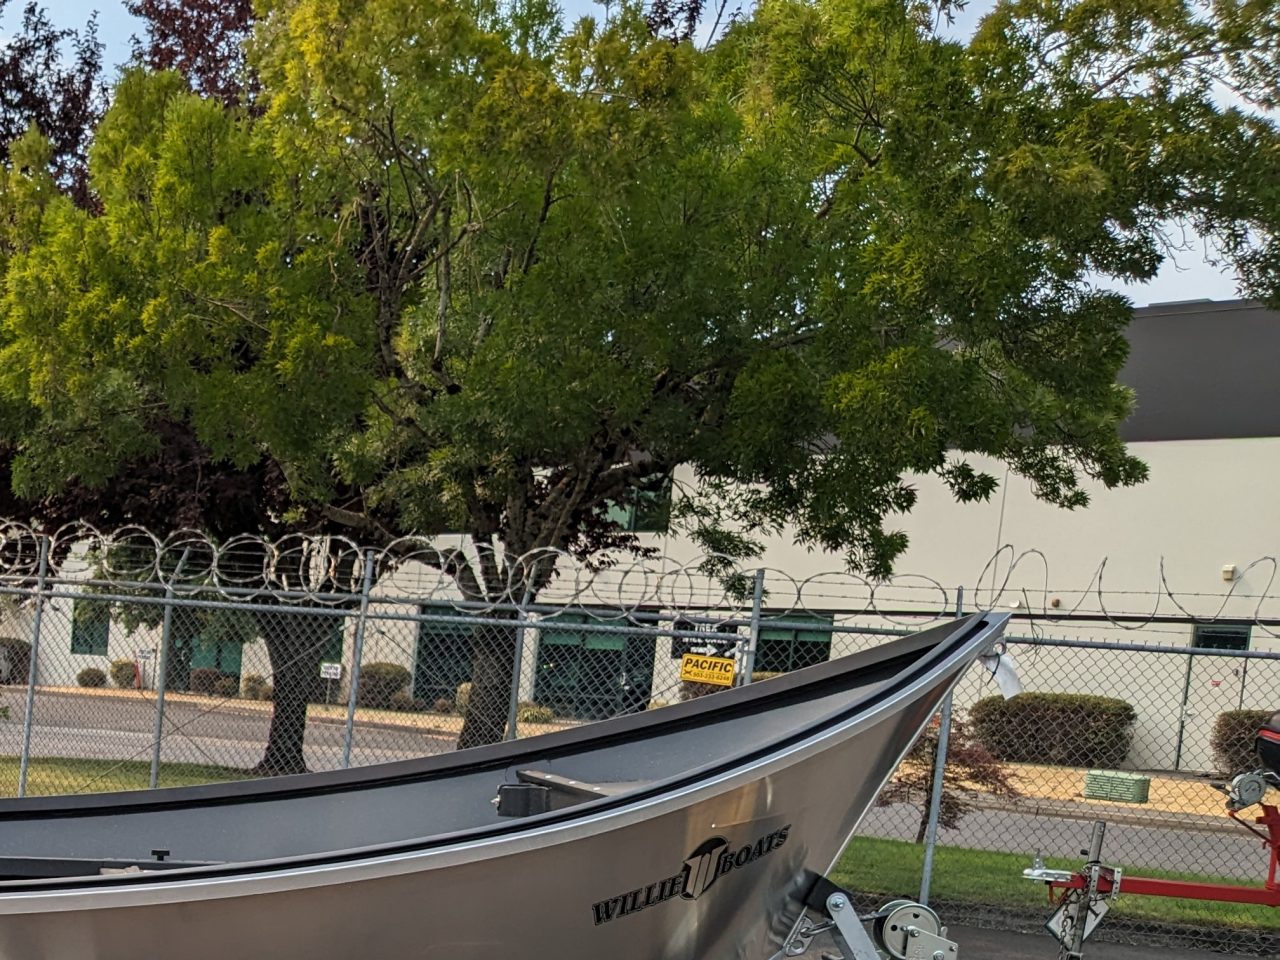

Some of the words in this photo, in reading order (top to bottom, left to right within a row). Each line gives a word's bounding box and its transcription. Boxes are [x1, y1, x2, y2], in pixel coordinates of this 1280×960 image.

[684, 658, 732, 673] PACIFIC
[592, 873, 685, 925] WILLIE
[719, 824, 792, 877] BOATS
